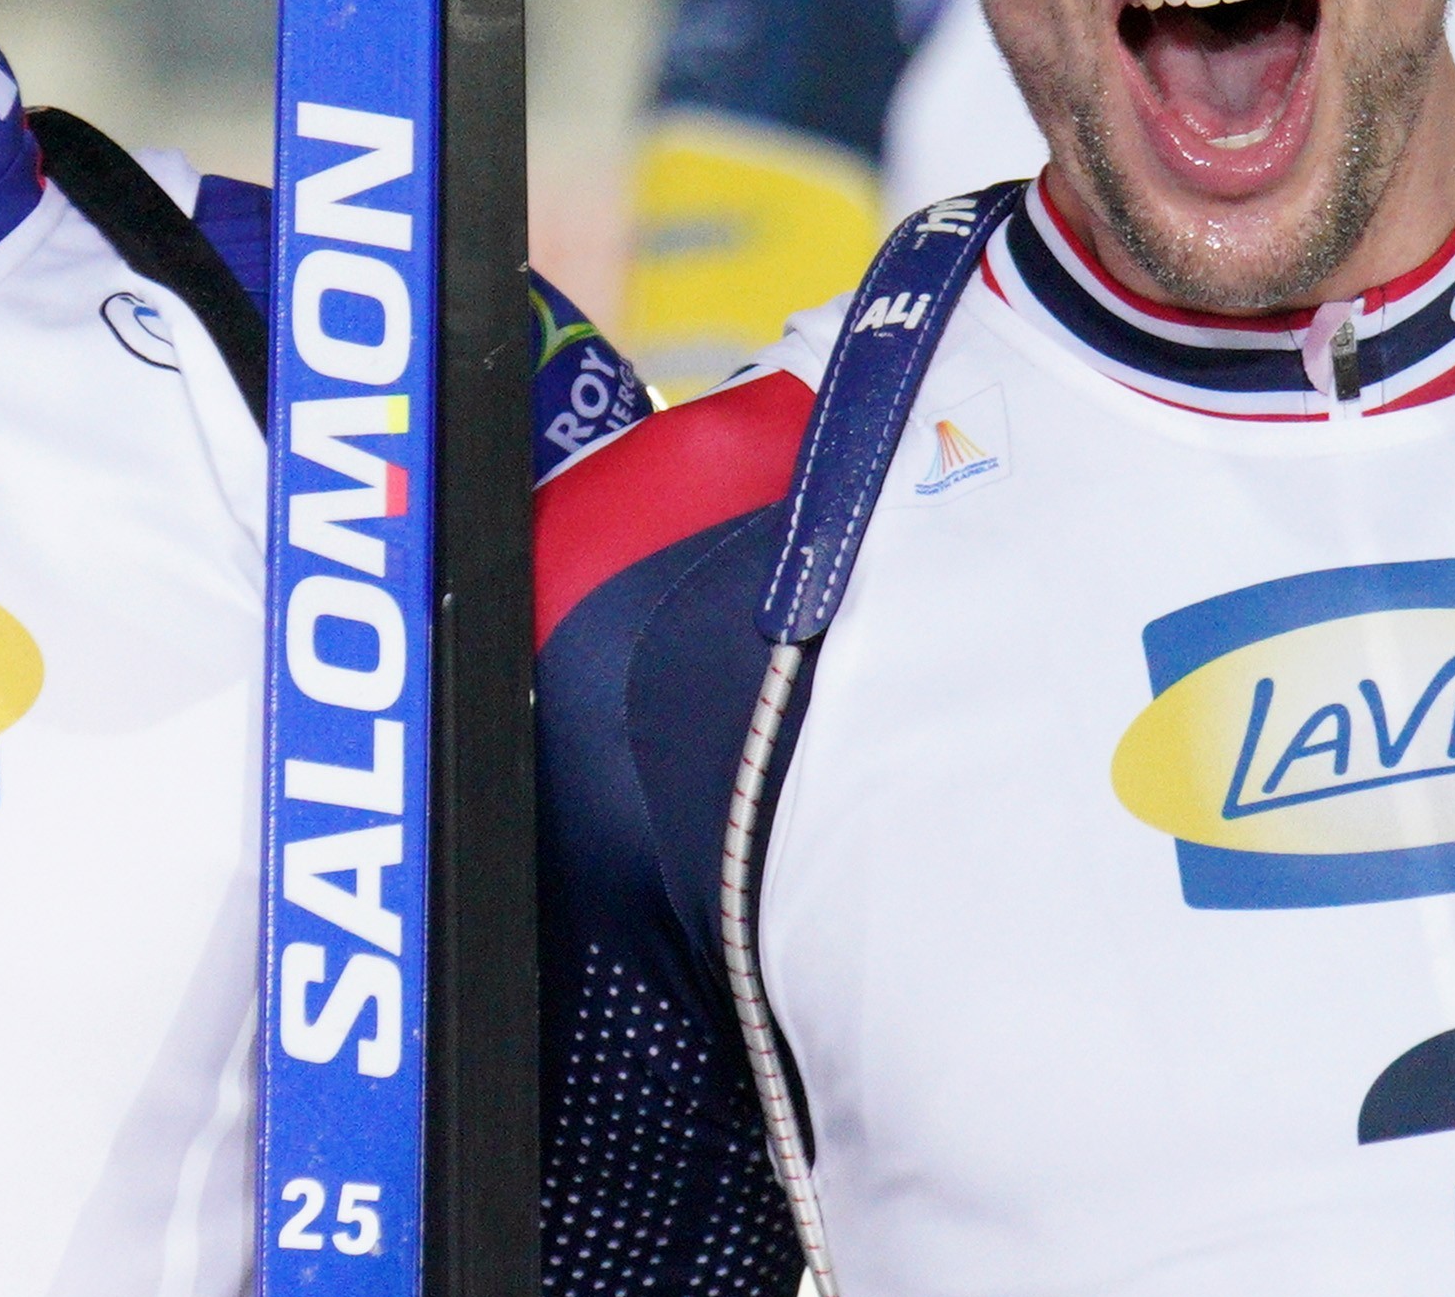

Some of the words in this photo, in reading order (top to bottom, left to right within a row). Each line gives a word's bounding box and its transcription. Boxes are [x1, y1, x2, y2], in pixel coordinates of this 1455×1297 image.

[544, 346, 616, 453] ROY
[279, 100, 415, 1080] SALOMON
[277, 1177, 382, 1255] 25
